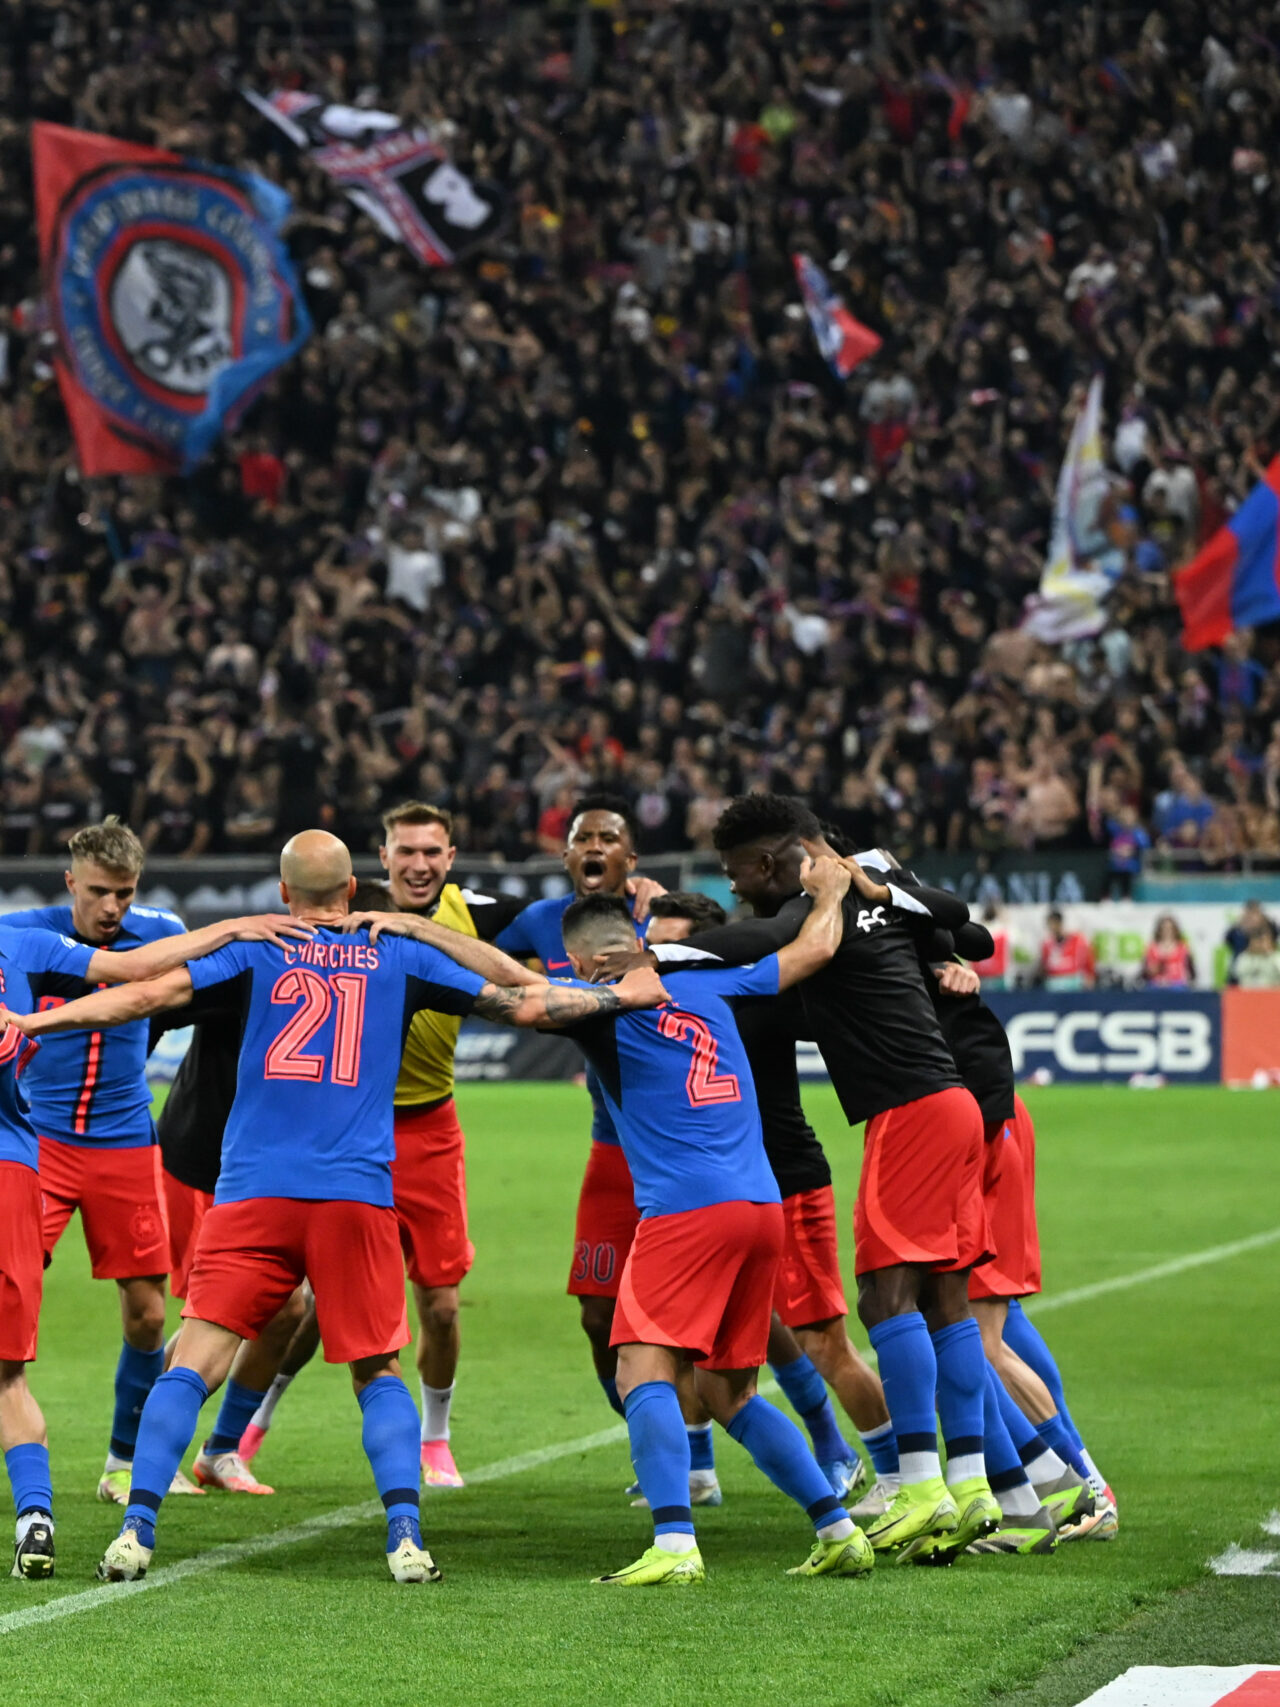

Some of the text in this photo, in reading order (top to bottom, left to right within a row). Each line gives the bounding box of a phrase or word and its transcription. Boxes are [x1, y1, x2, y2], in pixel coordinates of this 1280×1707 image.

[264, 967, 368, 1087] 21
[656, 1010, 742, 1108] 2
[1006, 1010, 1213, 1074] FCSB
[574, 1240, 616, 1285] 30
